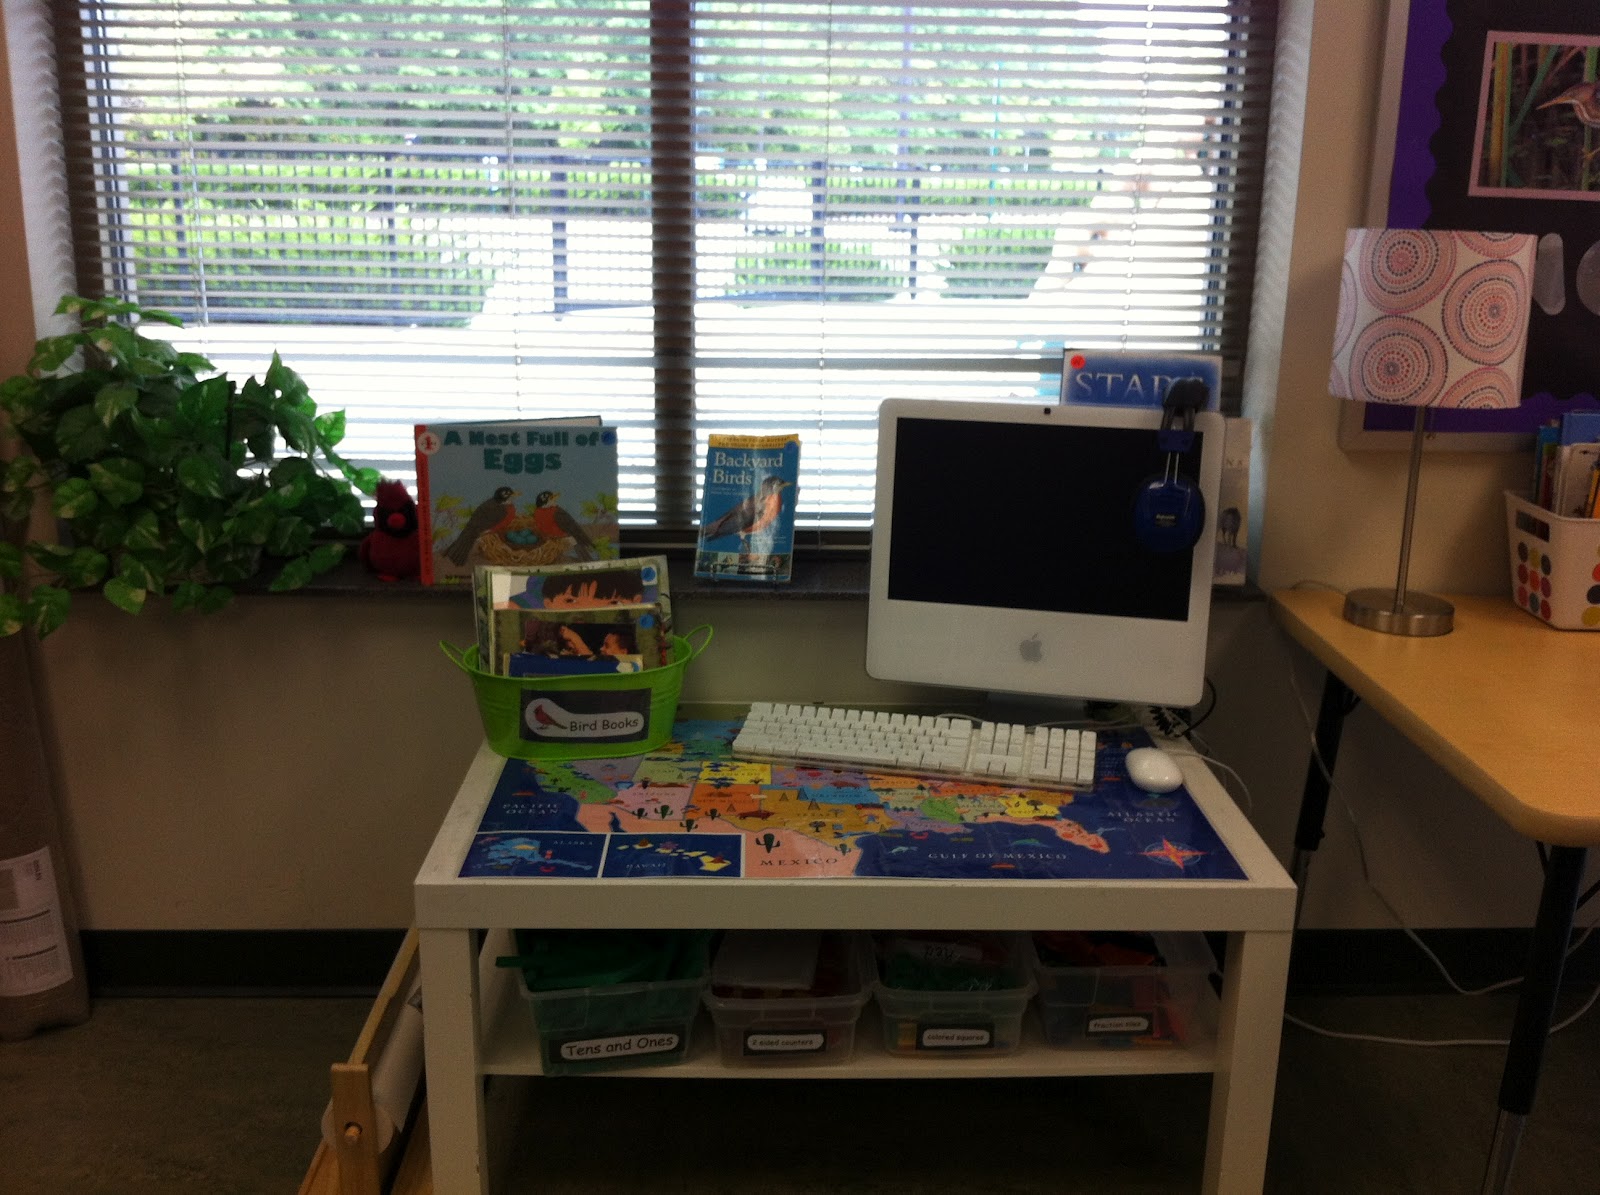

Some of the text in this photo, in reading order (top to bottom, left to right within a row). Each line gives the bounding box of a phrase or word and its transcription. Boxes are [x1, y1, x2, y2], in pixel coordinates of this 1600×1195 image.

[1075, 372, 1204, 401] STAR
[443, 430, 600, 447] A Nest Full of
[483, 448, 562, 474] Eggs
[715, 451, 783, 469] Backyard
[713, 470, 752, 485] Birds
[570, 717, 639, 732] Bird Books
[759, 857, 839, 867] MEXICO
[927, 852, 969, 860] GULF
[1003, 852, 1067, 860] MEXICO
[565, 1036, 674, 1056] Tens and Ones
[956, 1034, 984, 1042] squares
